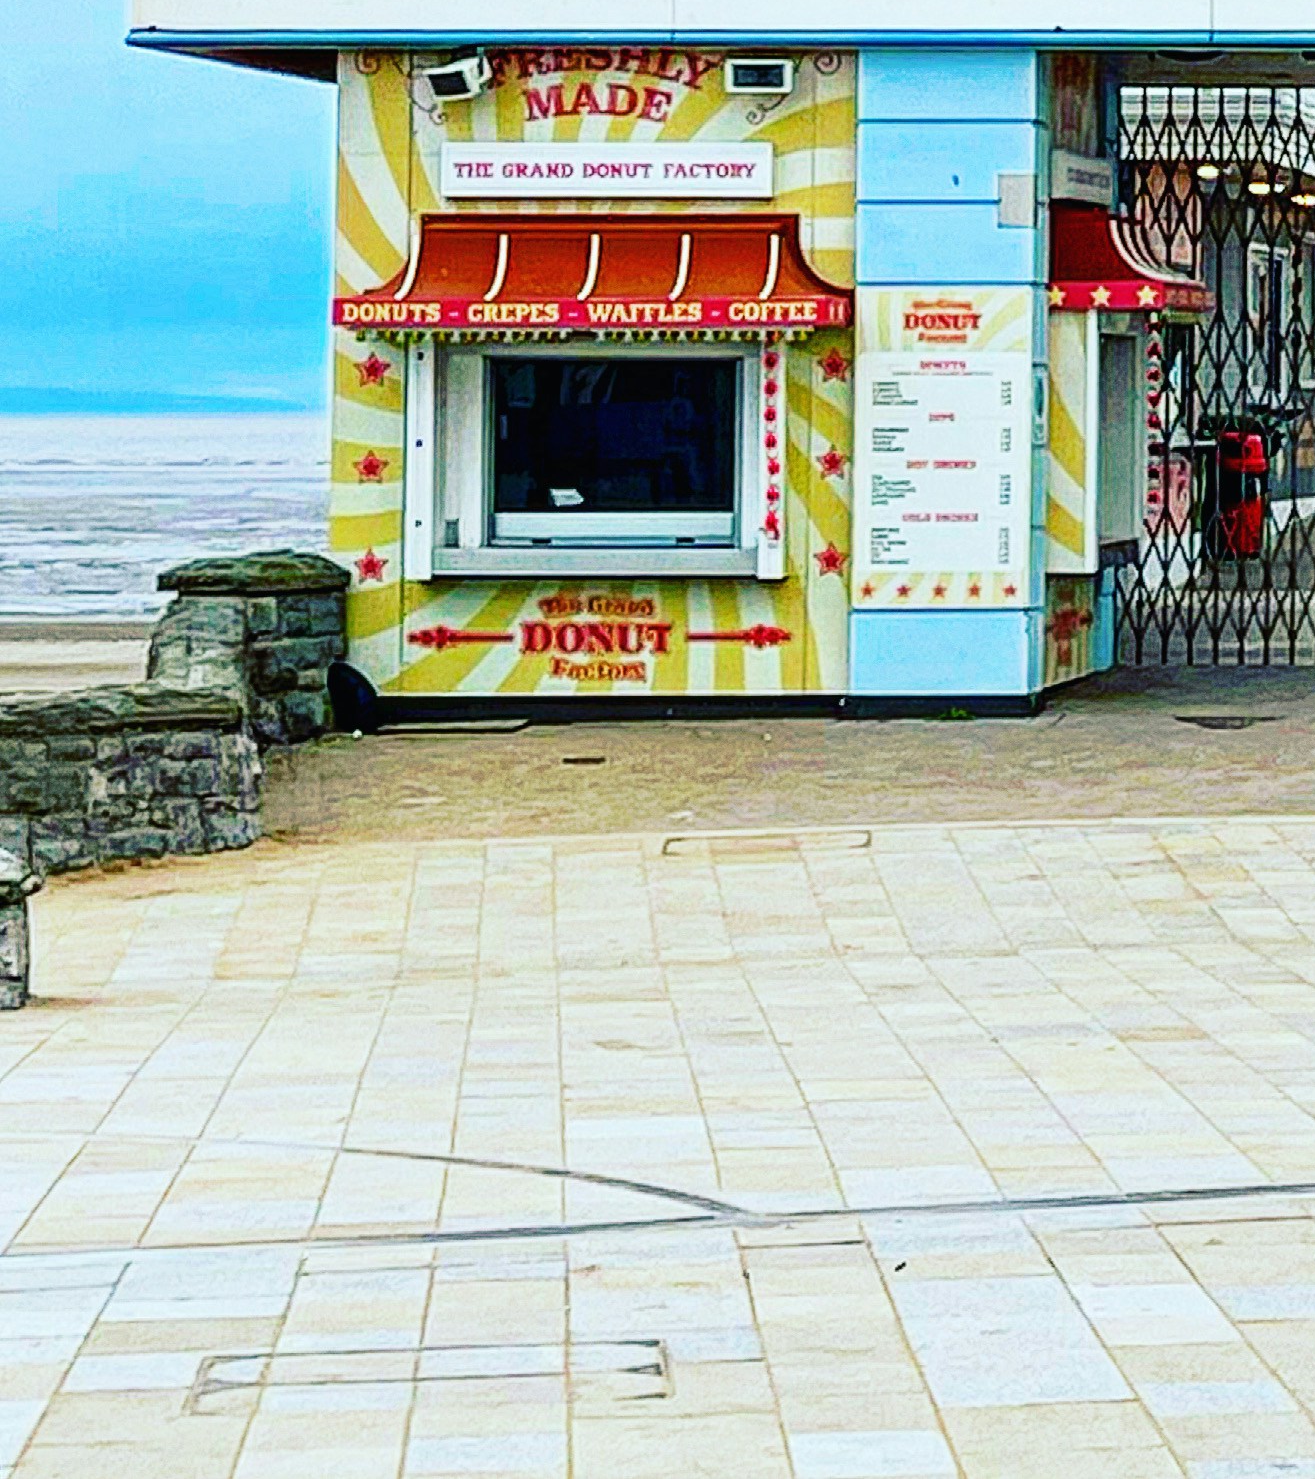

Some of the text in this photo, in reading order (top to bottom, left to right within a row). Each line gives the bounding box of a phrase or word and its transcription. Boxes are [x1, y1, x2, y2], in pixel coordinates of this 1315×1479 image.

[485, 48, 720, 90] FRESHLY
[522, 82, 674, 122] MADE
[453, 162, 757, 179] THE GRAND DONUT FACTORY
[342, 301, 442, 324] DONUTS
[467, 302, 561, 323] CREPES
[586, 302, 703, 323] WAFFLES
[728, 301, 819, 323] COFFEE
[903, 313, 983, 331] DONUT
[520, 622, 673, 655] DONUT
